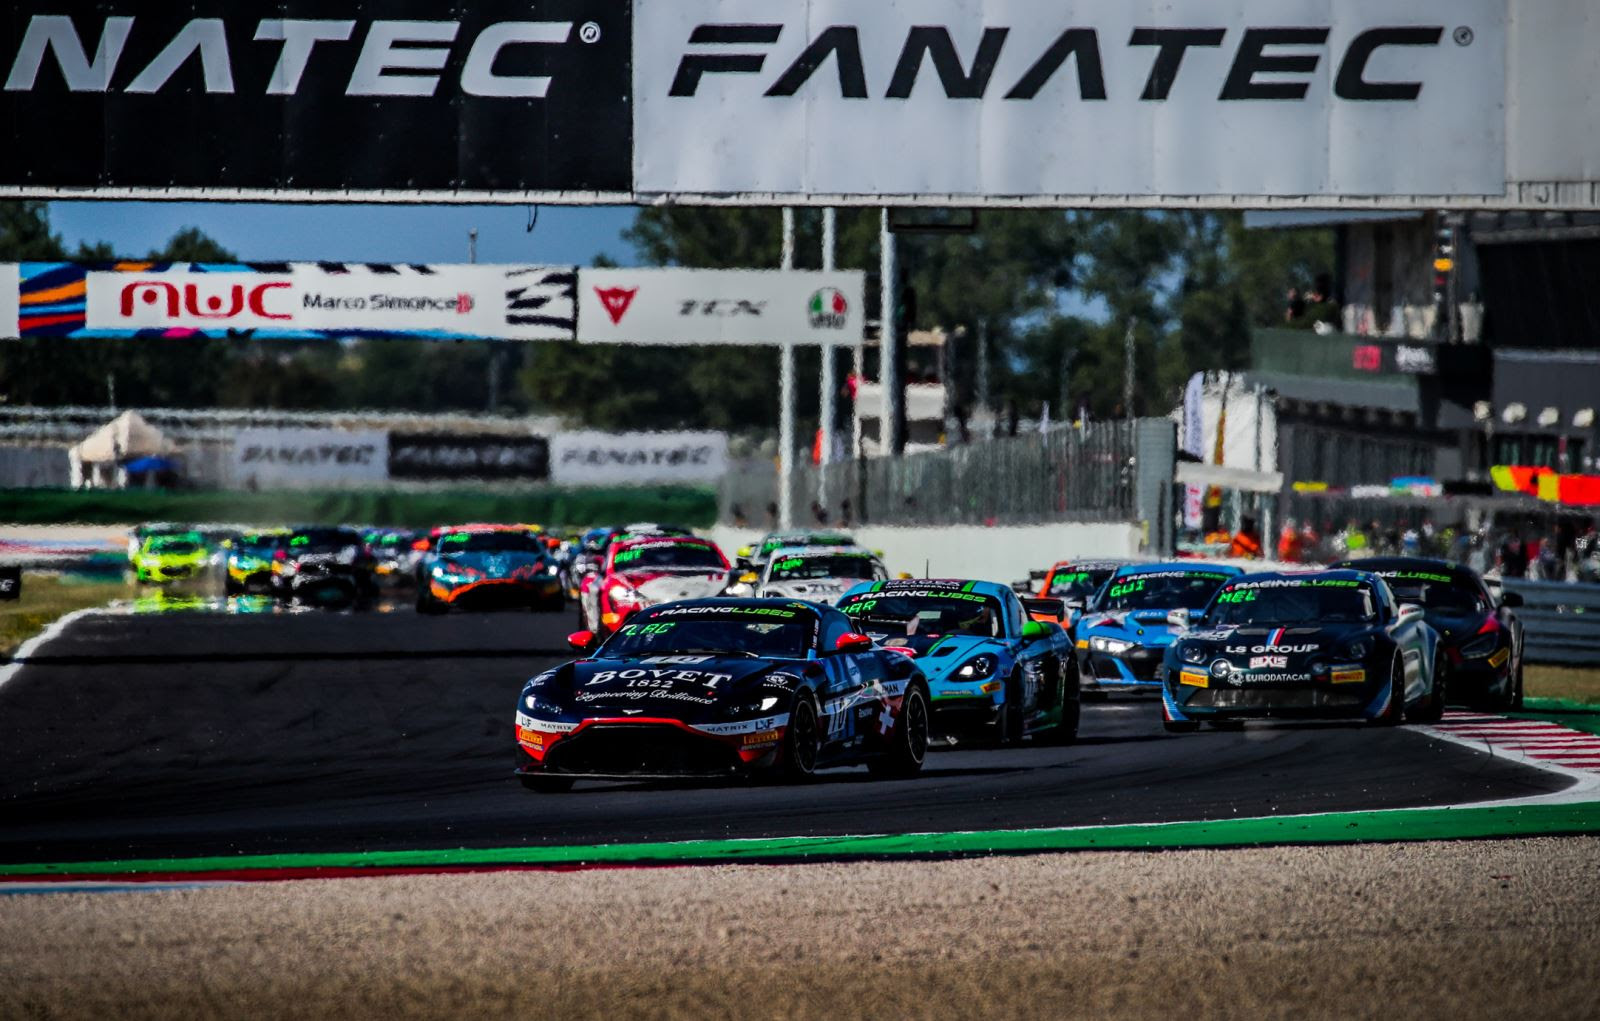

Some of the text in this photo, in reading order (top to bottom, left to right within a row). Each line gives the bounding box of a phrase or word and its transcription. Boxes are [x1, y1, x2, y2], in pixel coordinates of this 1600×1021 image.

[4, 15, 573, 97] NATEC
[667, 24, 1444, 101] FANATEC
[303, 293, 365, 310] Marco
[1225, 644, 1320, 654] LS GROUP
[584, 669, 733, 689] BOVET
[626, 679, 674, 689] 1822
[1244, 673, 1312, 683] EURODATACAR
[575, 690, 649, 703] Engineering
[707, 724, 748, 732] MATRIX
